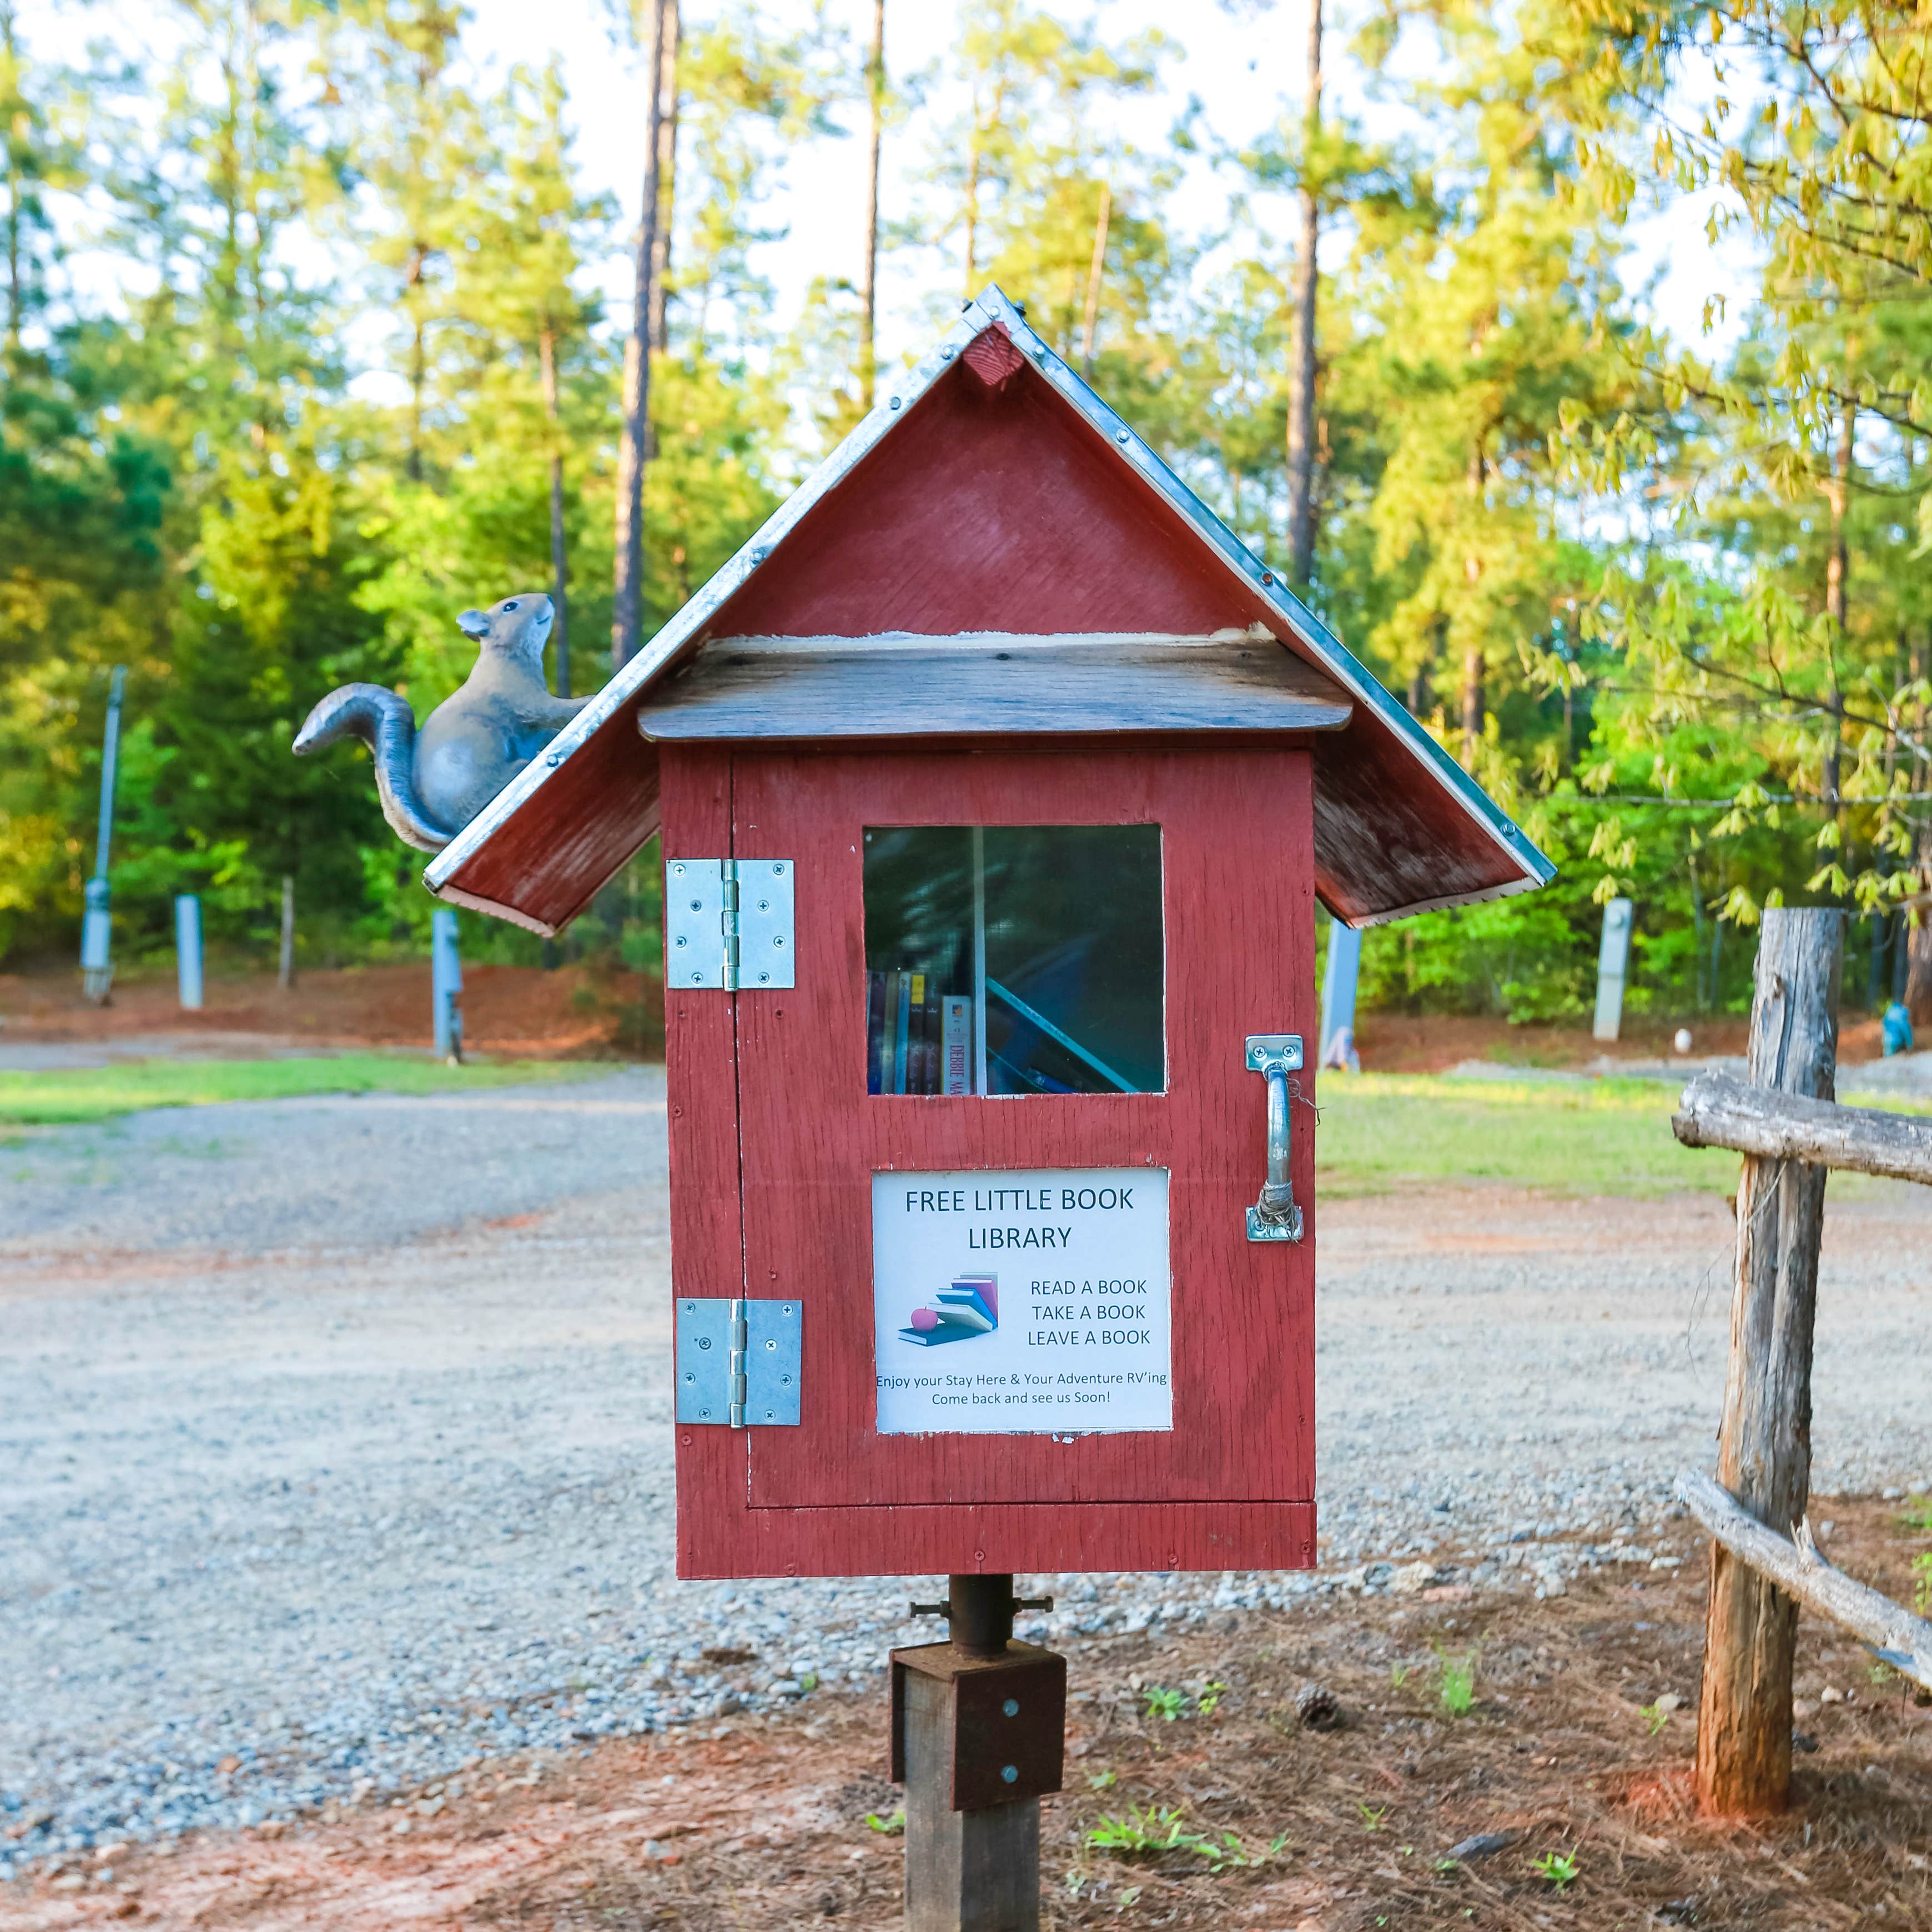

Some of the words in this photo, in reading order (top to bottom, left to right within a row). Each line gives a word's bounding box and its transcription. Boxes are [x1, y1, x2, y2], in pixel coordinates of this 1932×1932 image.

[950, 1045, 964, 1077] DEBBIE
[907, 1190, 965, 1212] FREE
[975, 1189, 1052, 1211] LITTLE
[1062, 1188, 1134, 1210] BOOK
[969, 1227, 1072, 1249] LIBRARY
[1031, 1280, 1075, 1295] READ
[1081, 1280, 1093, 1295] A
[1099, 1280, 1148, 1294] BOOK
[1032, 1306, 1074, 1320] TAKE
[1079, 1305, 1092, 1320] A
[1097, 1305, 1146, 1320] BOOK
[1028, 1331, 1079, 1345] LEAVE
[1084, 1331, 1096, 1345] A
[1102, 1330, 1151, 1345] BOOK
[876, 1375, 910, 1388] Enjoy
[913, 1377, 943, 1389] your
[946, 1375, 973, 1388] Stay
[977, 1374, 1007, 1385] Here
[1010, 1373, 1020, 1385] &
[1024, 1373, 1054, 1385] Your
[1056, 1372, 1123, 1385] Adventure
[932, 1393, 968, 1405] Come
[972, 1392, 1001, 1404] back
[1004, 1392, 1028, 1403] and
[1032, 1395, 1053, 1403] see
[1057, 1394, 1071, 1403] us
[1074, 1391, 1110, 1403] Soon!
